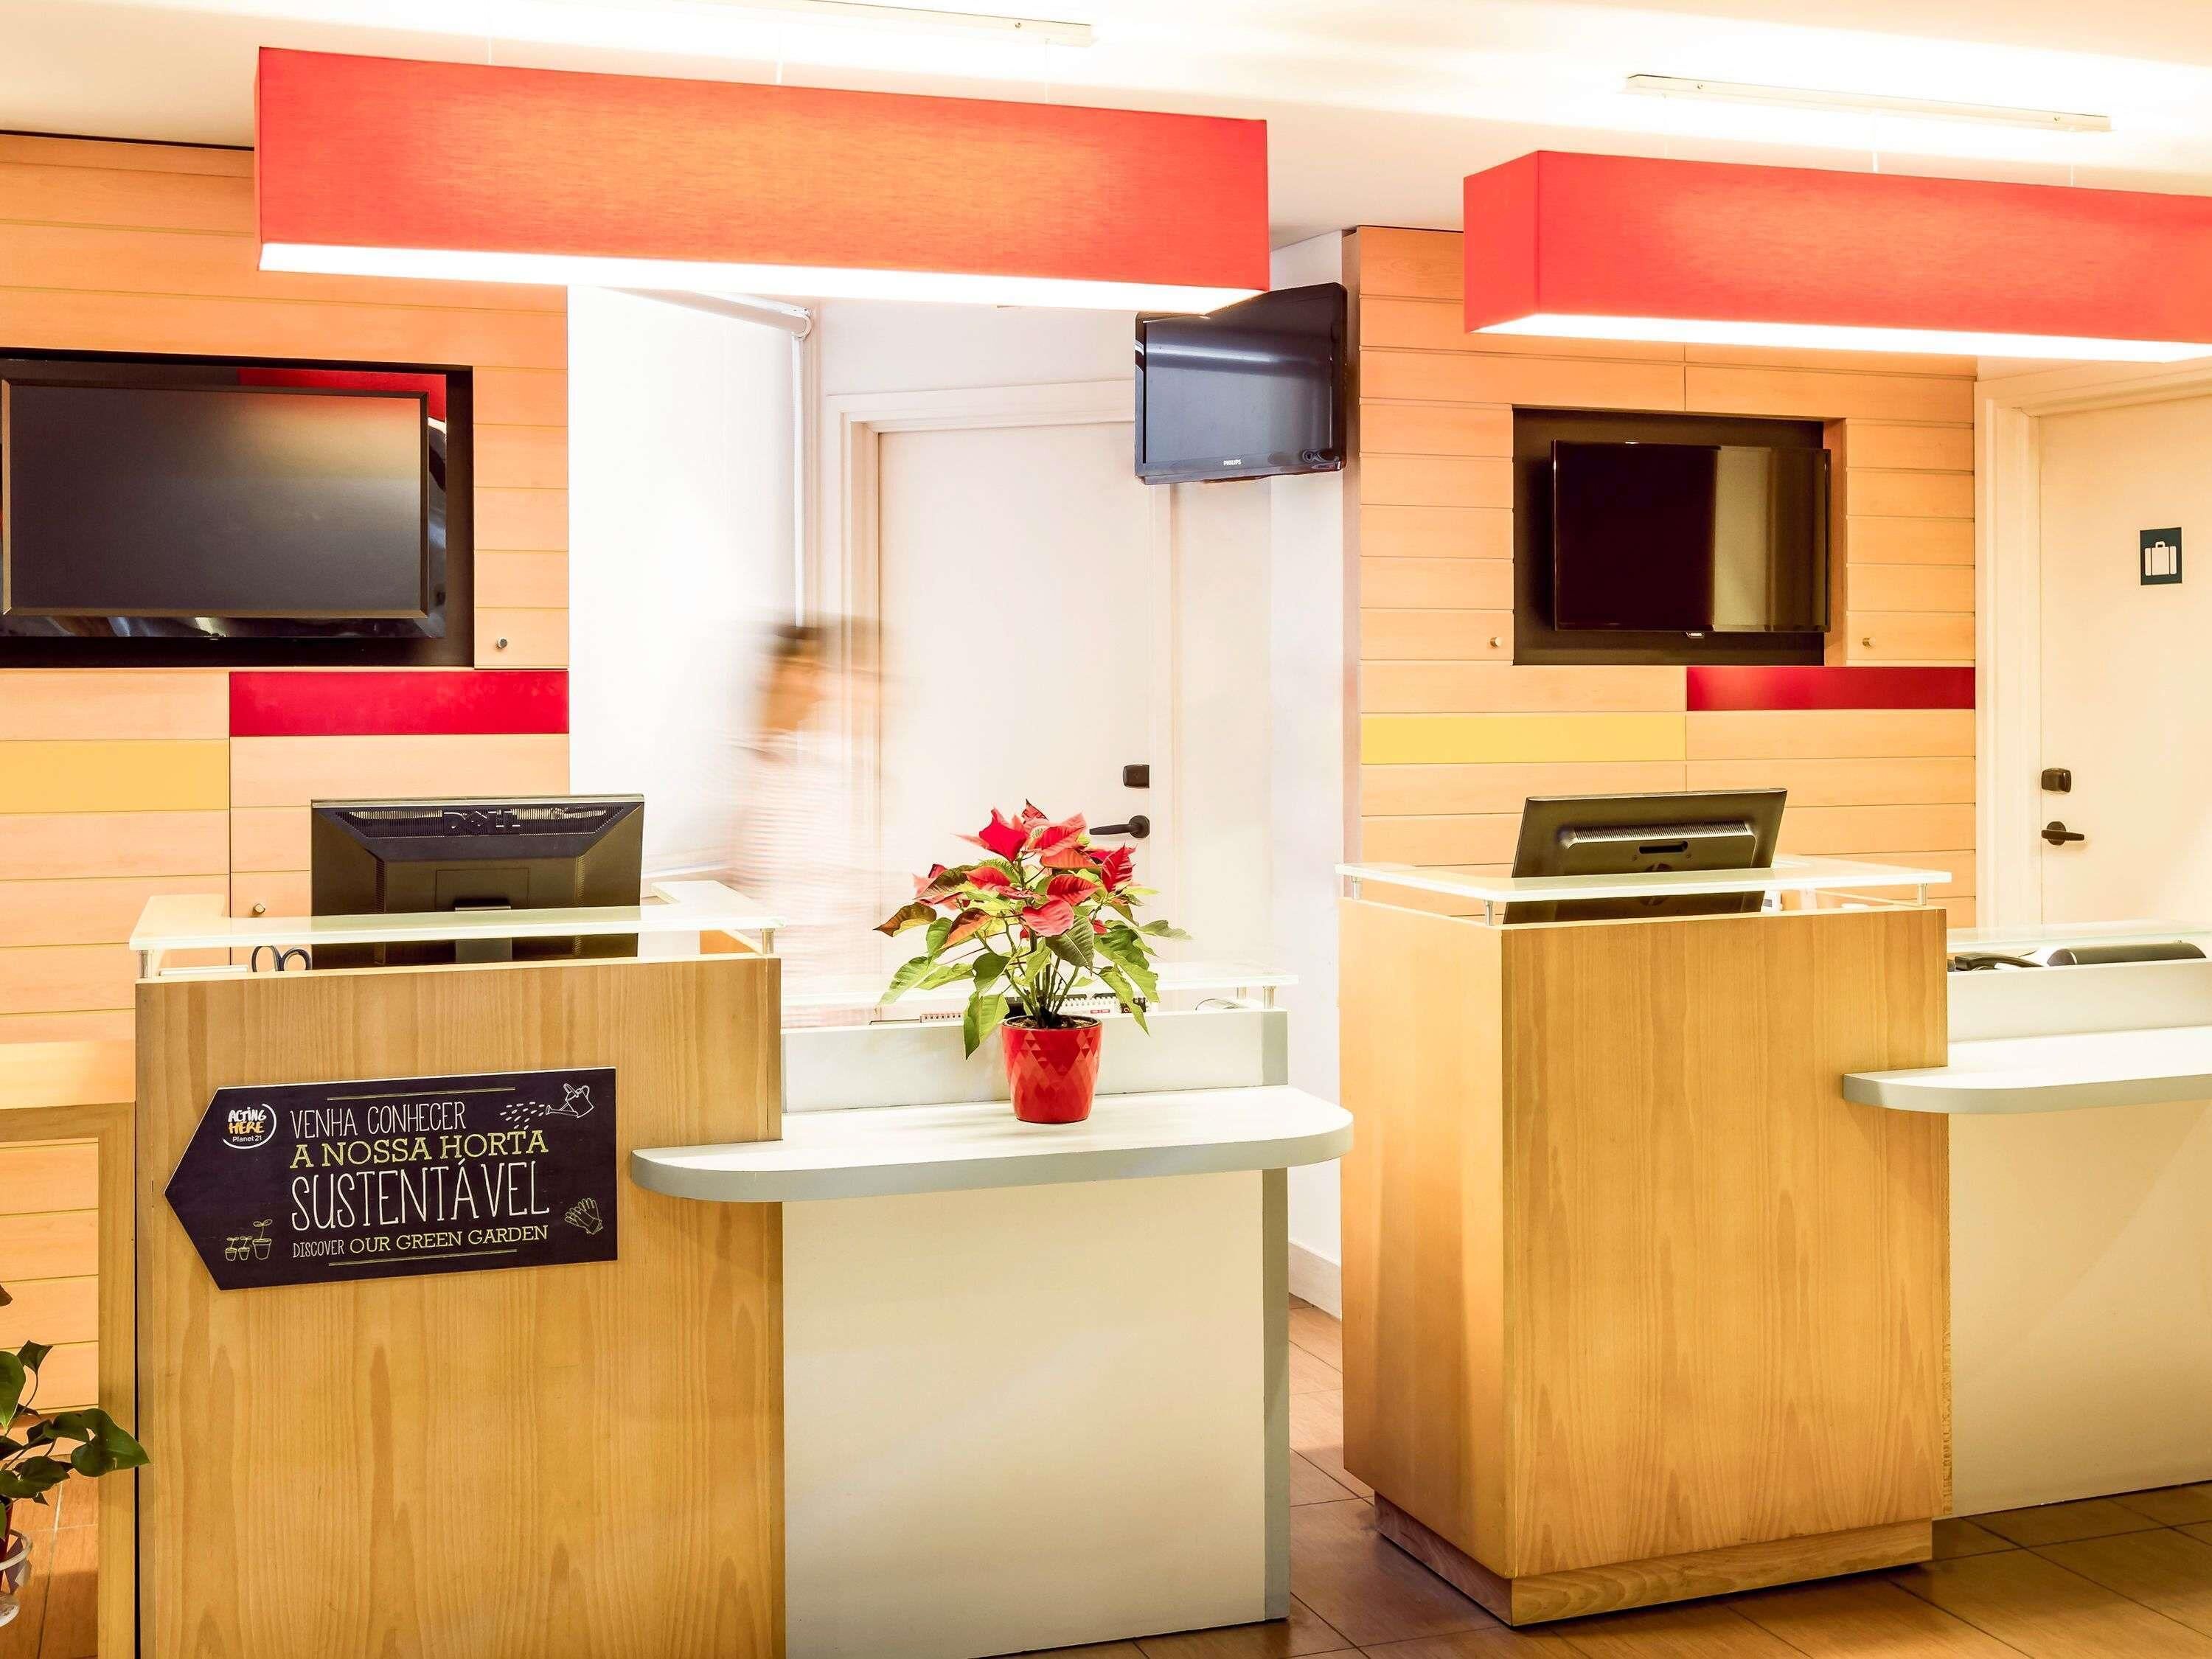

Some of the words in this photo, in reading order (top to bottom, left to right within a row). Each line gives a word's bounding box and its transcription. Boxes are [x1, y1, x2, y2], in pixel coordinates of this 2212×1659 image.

[229, 1121, 265, 1134] HERE
[290, 1108, 358, 1138] VENHA
[367, 1102, 466, 1135] CONHECER
[290, 1144, 313, 1169] A
[321, 1137, 432, 1166] NOSSA
[439, 1130, 549, 1160] HORTA
[291, 1158, 550, 1231] SUSTENTÁVEL
[293, 1239, 344, 1258] DISCOVER
[349, 1237, 391, 1253] OUR
[396, 1231, 462, 1250] GREEN
[468, 1225, 549, 1245] GARDEN
